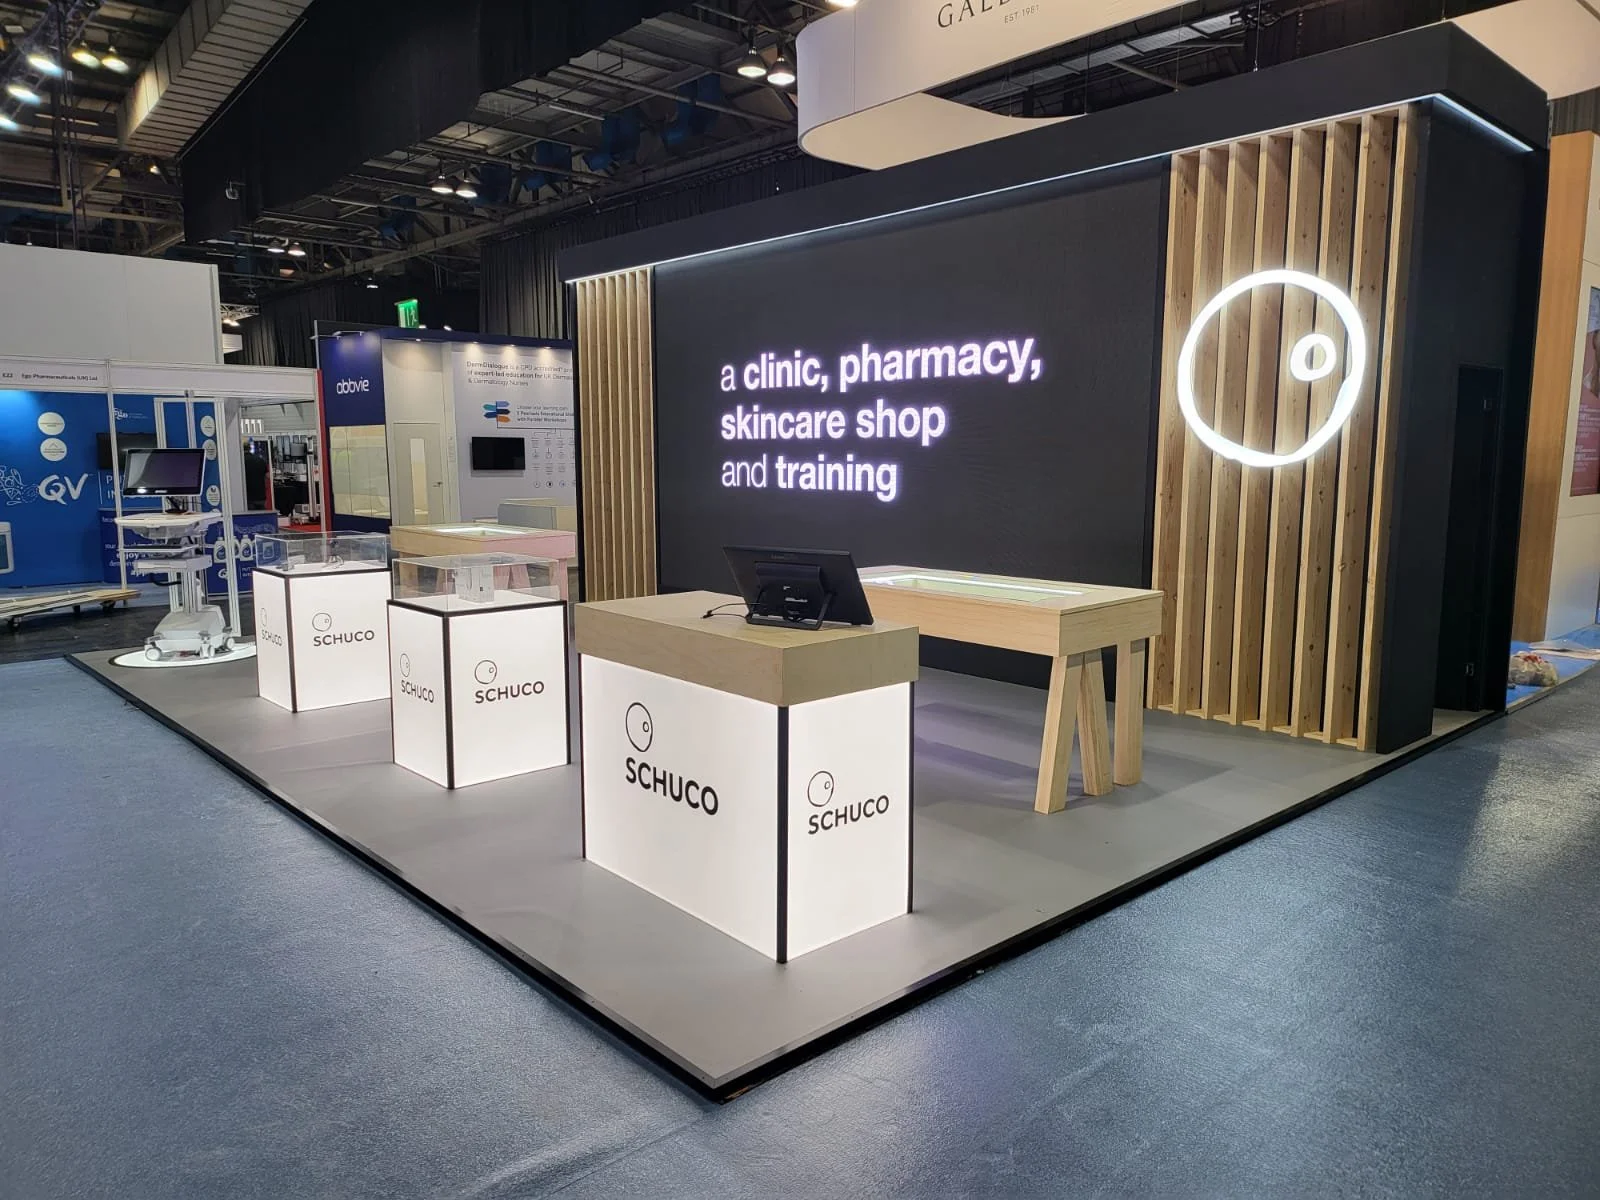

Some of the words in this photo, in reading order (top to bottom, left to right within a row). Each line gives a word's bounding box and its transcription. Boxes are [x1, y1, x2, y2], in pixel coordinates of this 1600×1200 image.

[720, 364, 737, 391] a
[743, 349, 829, 392] clinic,
[839, 338, 1041, 393] pharmacy,
[336, 377, 369, 394] abbvie
[720, 404, 846, 440] skincare
[856, 399, 947, 447] shop
[39, 473, 89, 505] QV
[721, 453, 767, 488] and
[775, 453, 898, 502] training
[313, 630, 375, 647] SCHUCO
[400, 679, 435, 703] SCHUCO
[475, 681, 545, 704] SCHUCO
[625, 756, 719, 816] SCHUCO
[808, 794, 890, 835] SCHUCO
